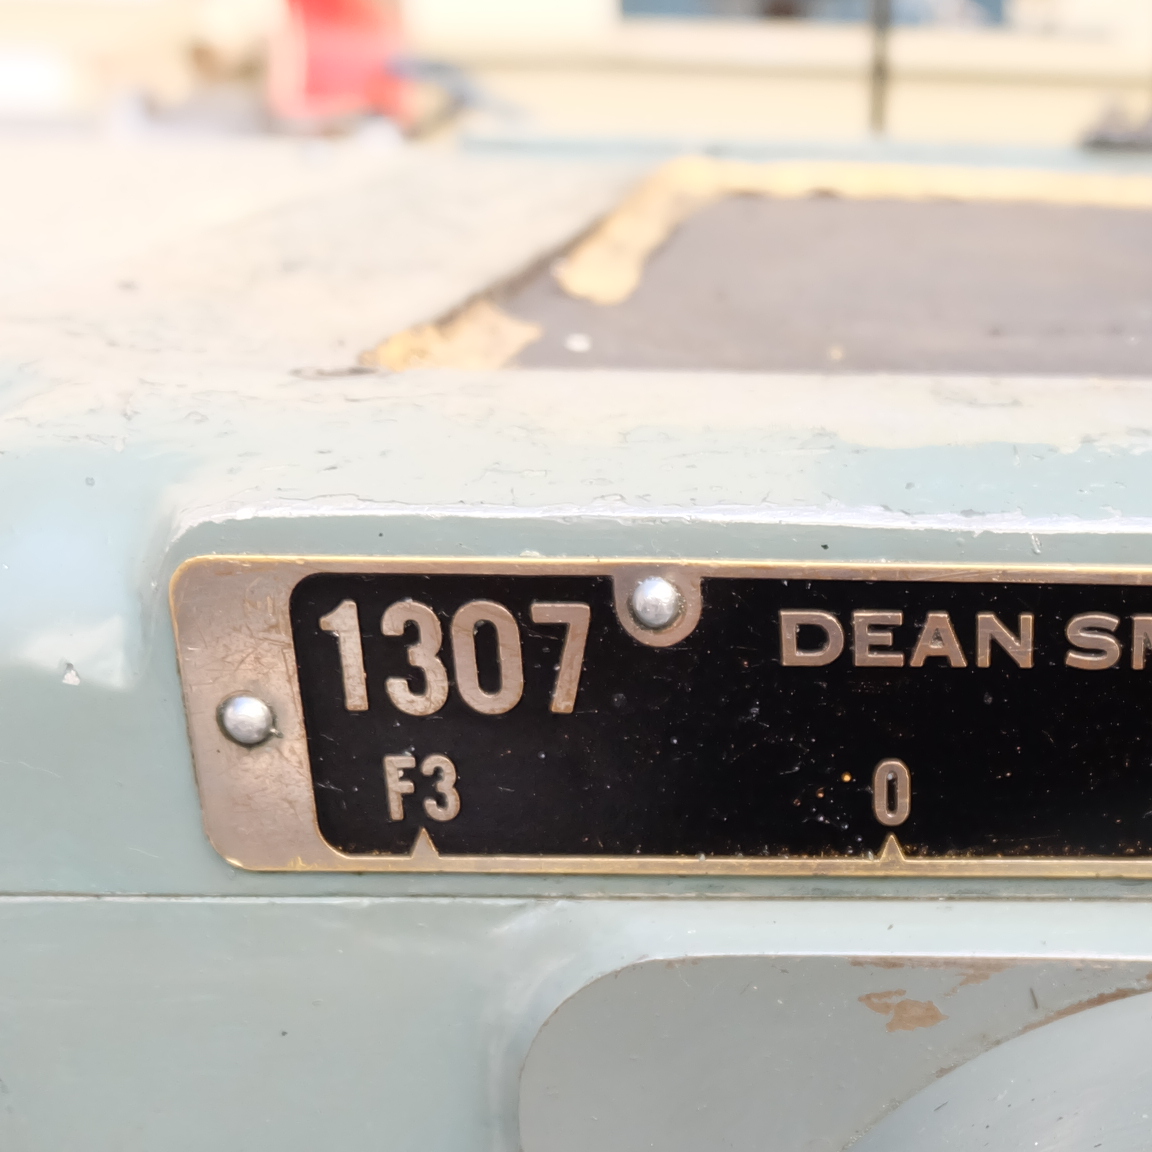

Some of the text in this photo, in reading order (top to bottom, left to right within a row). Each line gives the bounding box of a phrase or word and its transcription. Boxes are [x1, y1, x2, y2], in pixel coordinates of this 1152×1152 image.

[319, 600, 591, 716] 1307
[779, 609, 1034, 669] DEAN
[384, 754, 461, 822] F3
